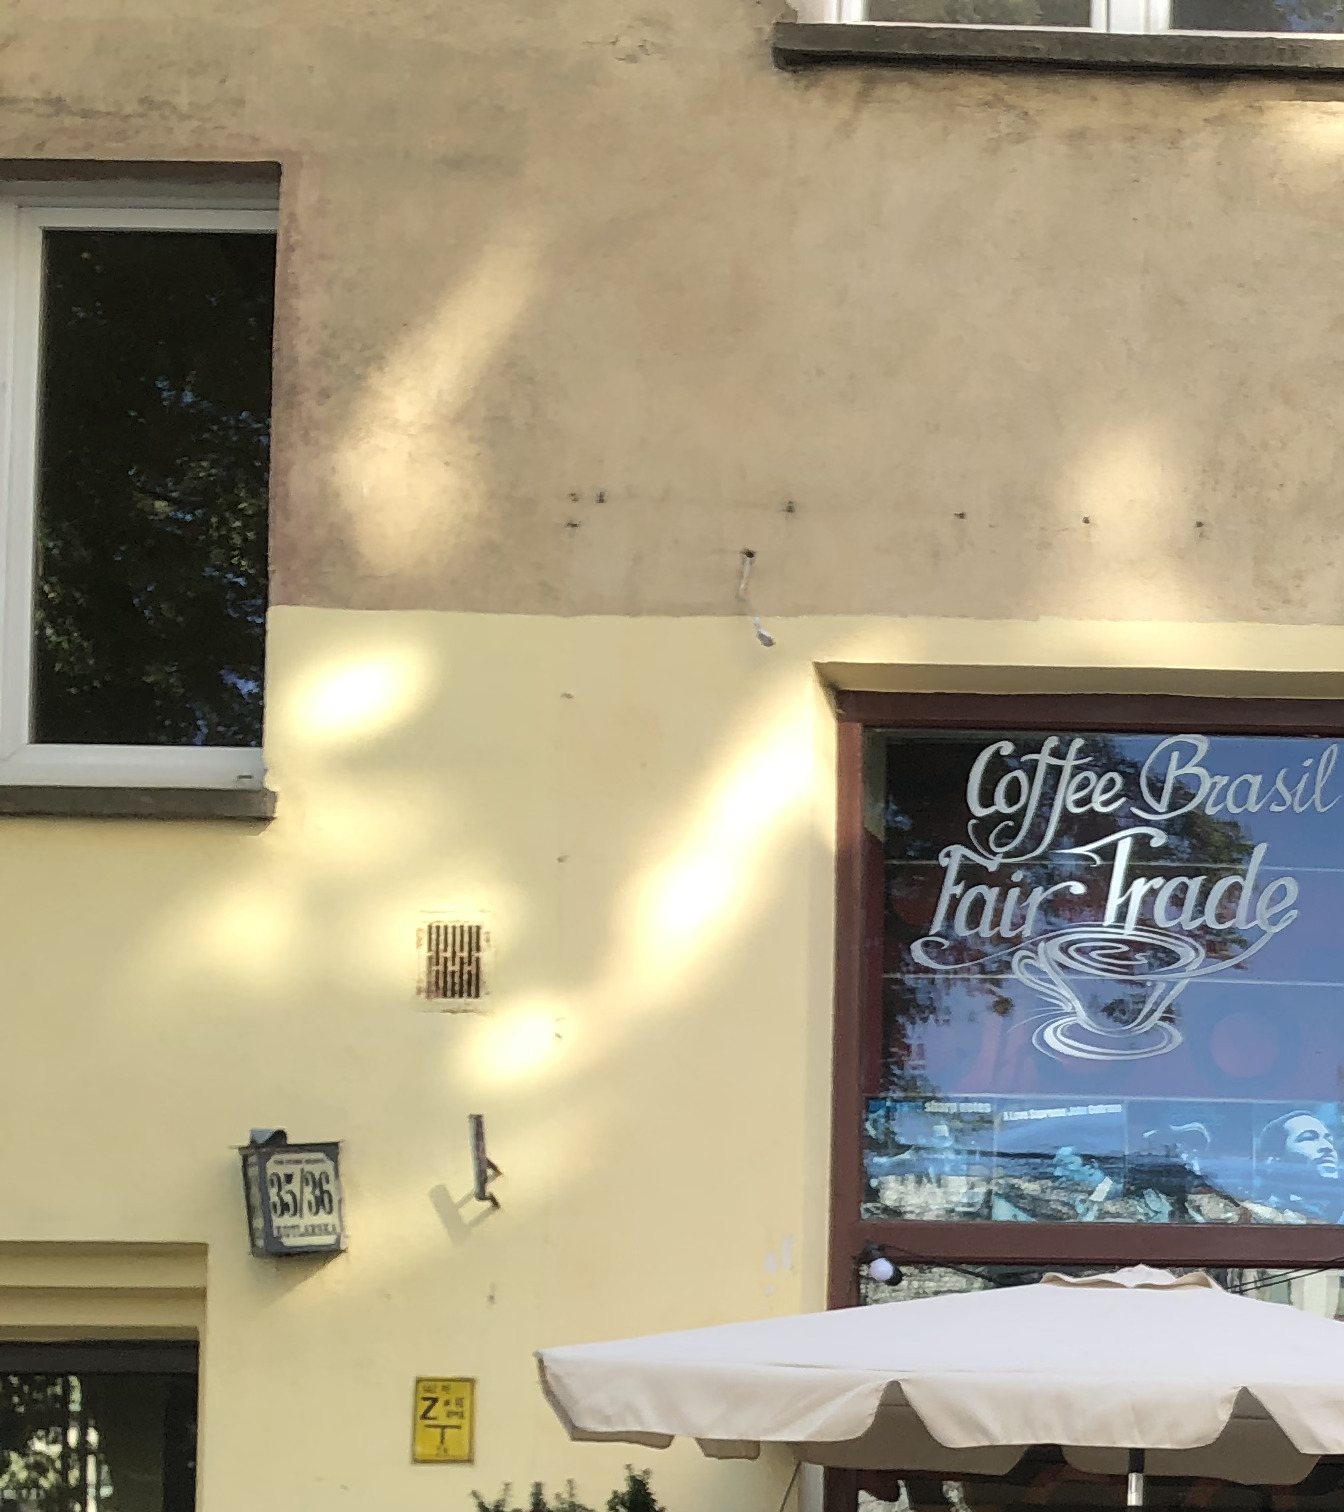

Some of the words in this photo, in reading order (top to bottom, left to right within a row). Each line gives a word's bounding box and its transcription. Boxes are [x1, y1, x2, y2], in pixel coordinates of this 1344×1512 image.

[965, 735, 1130, 858] Coffee
[1131, 733, 1342, 819] Brasil
[929, 843, 1087, 938] Fair
[1052, 826, 1299, 936] Trade
[419, 1396, 439, 1421] Z
